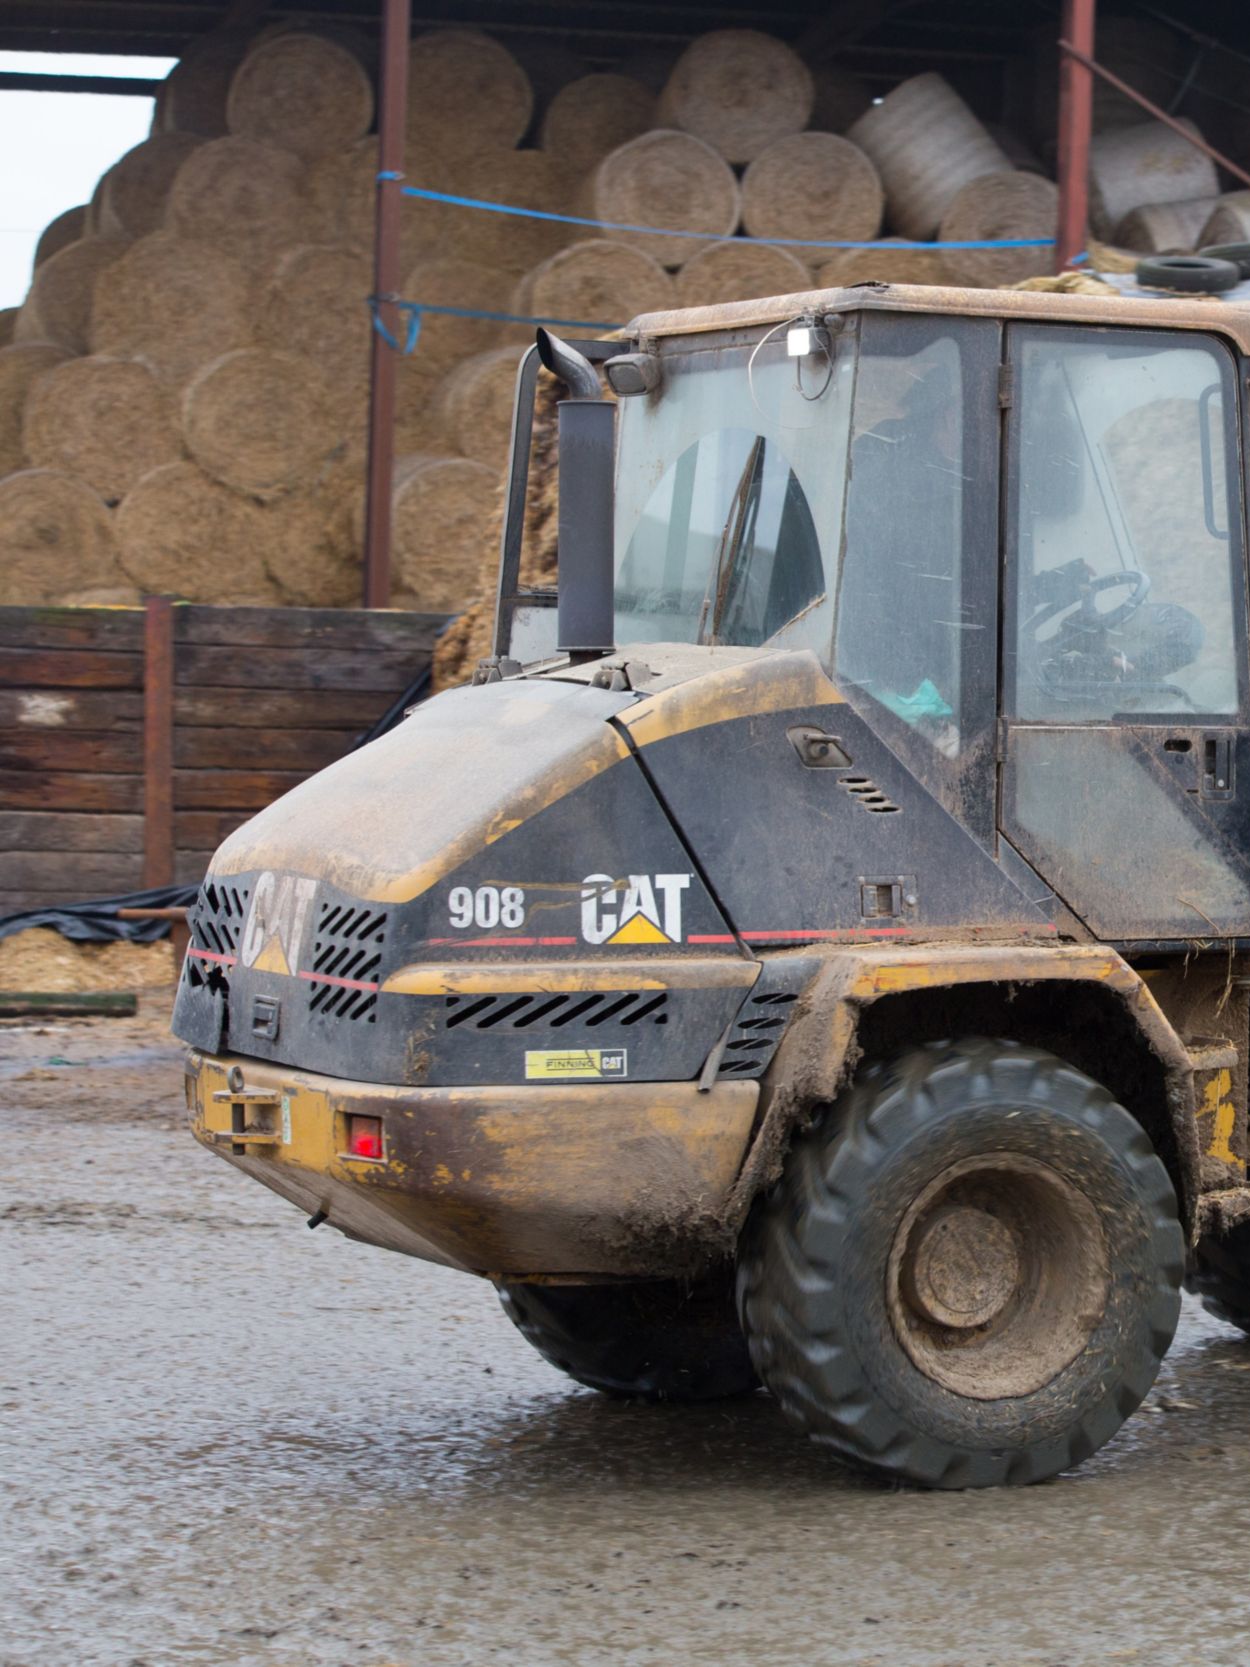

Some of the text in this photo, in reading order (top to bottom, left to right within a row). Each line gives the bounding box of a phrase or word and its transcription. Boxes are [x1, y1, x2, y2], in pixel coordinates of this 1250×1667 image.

[241, 871, 317, 977] CAT
[448, 886, 525, 928] 908
[581, 873, 691, 944] CAT
[545, 1060, 595, 1069] FINNING
[602, 1056, 622, 1069] CAT
